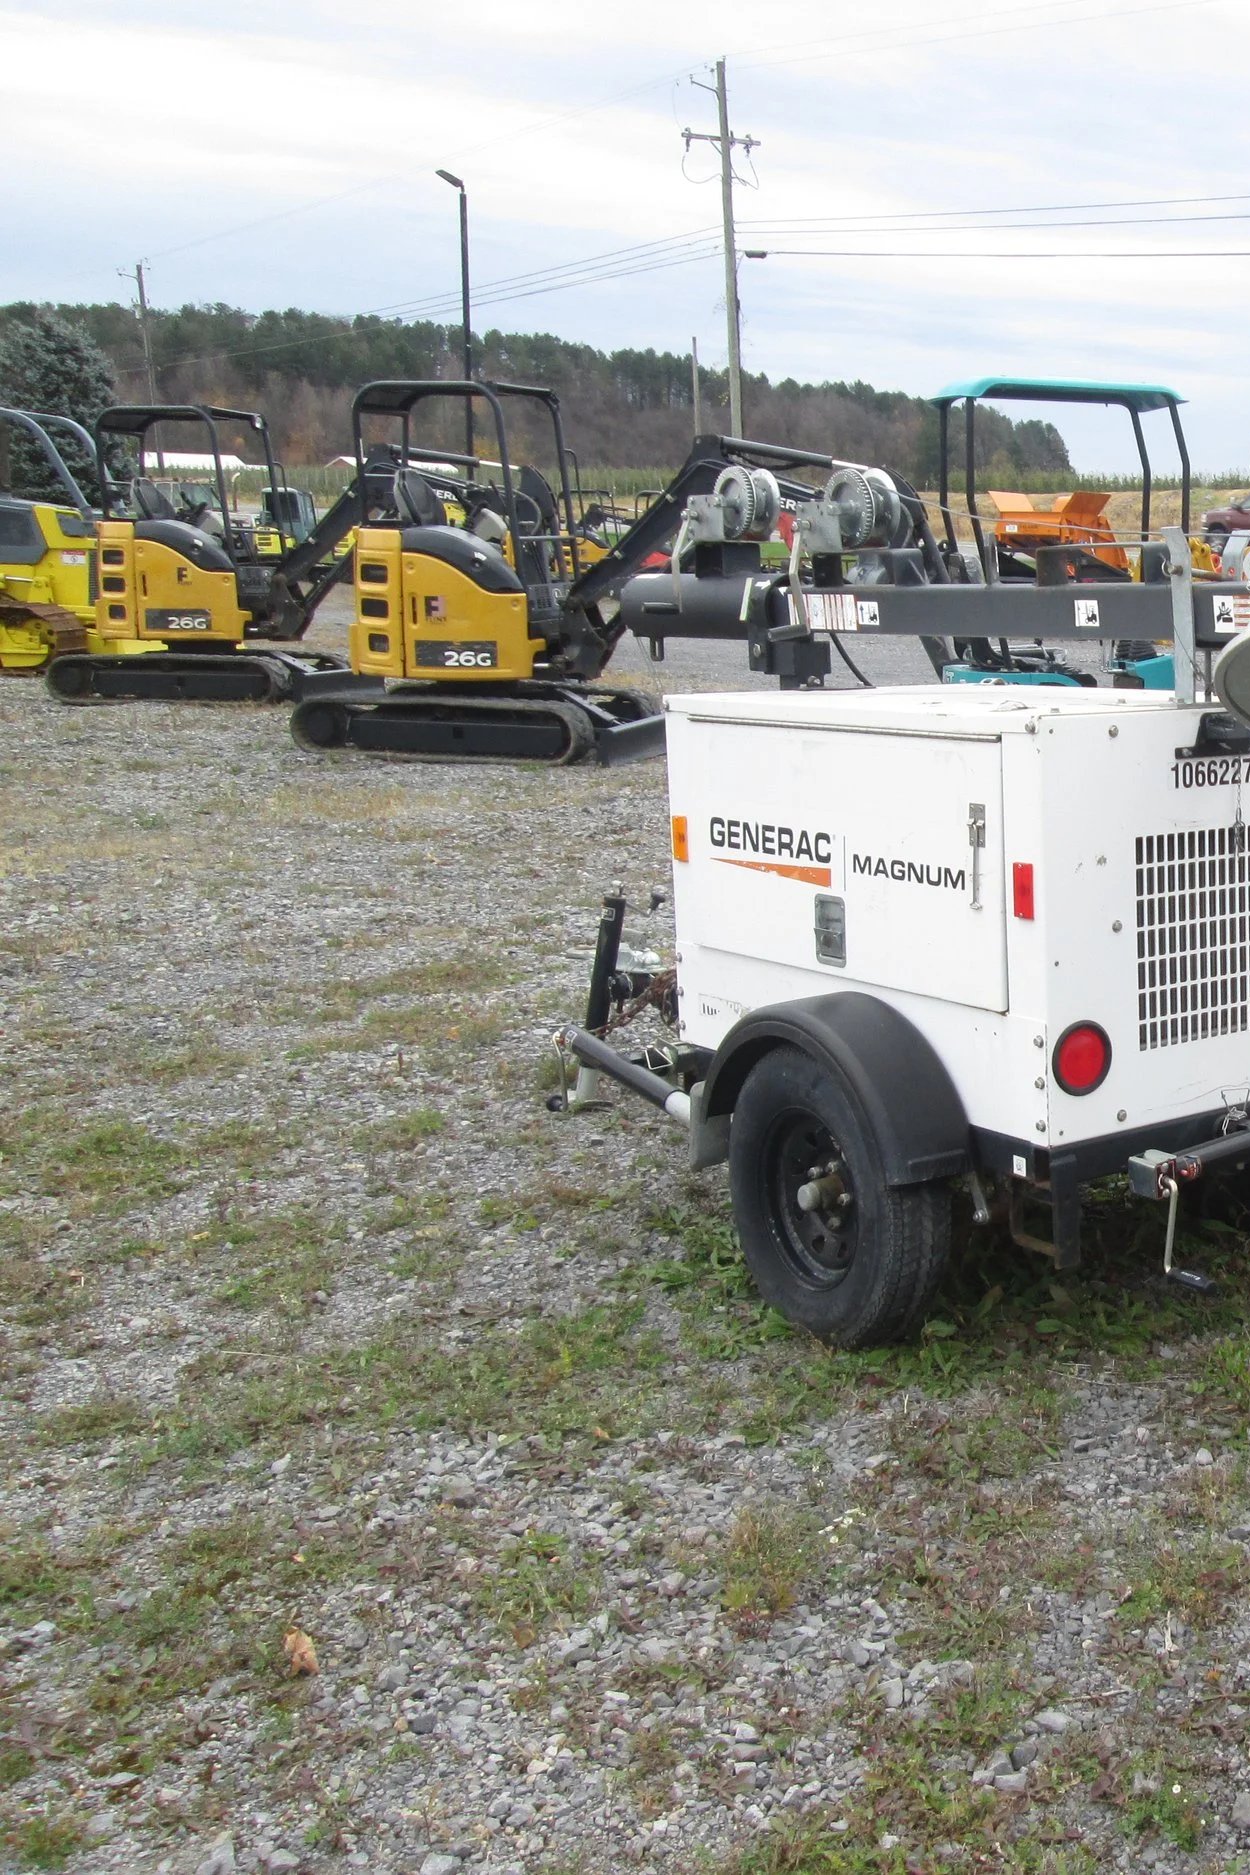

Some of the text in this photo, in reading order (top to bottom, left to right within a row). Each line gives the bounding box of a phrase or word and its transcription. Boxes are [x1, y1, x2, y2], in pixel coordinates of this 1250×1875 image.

[168, 617, 207, 630] 26G
[444, 651, 492, 667] 26G
[709, 816, 832, 863] GENERAC
[852, 853, 966, 890] MAGNUM
